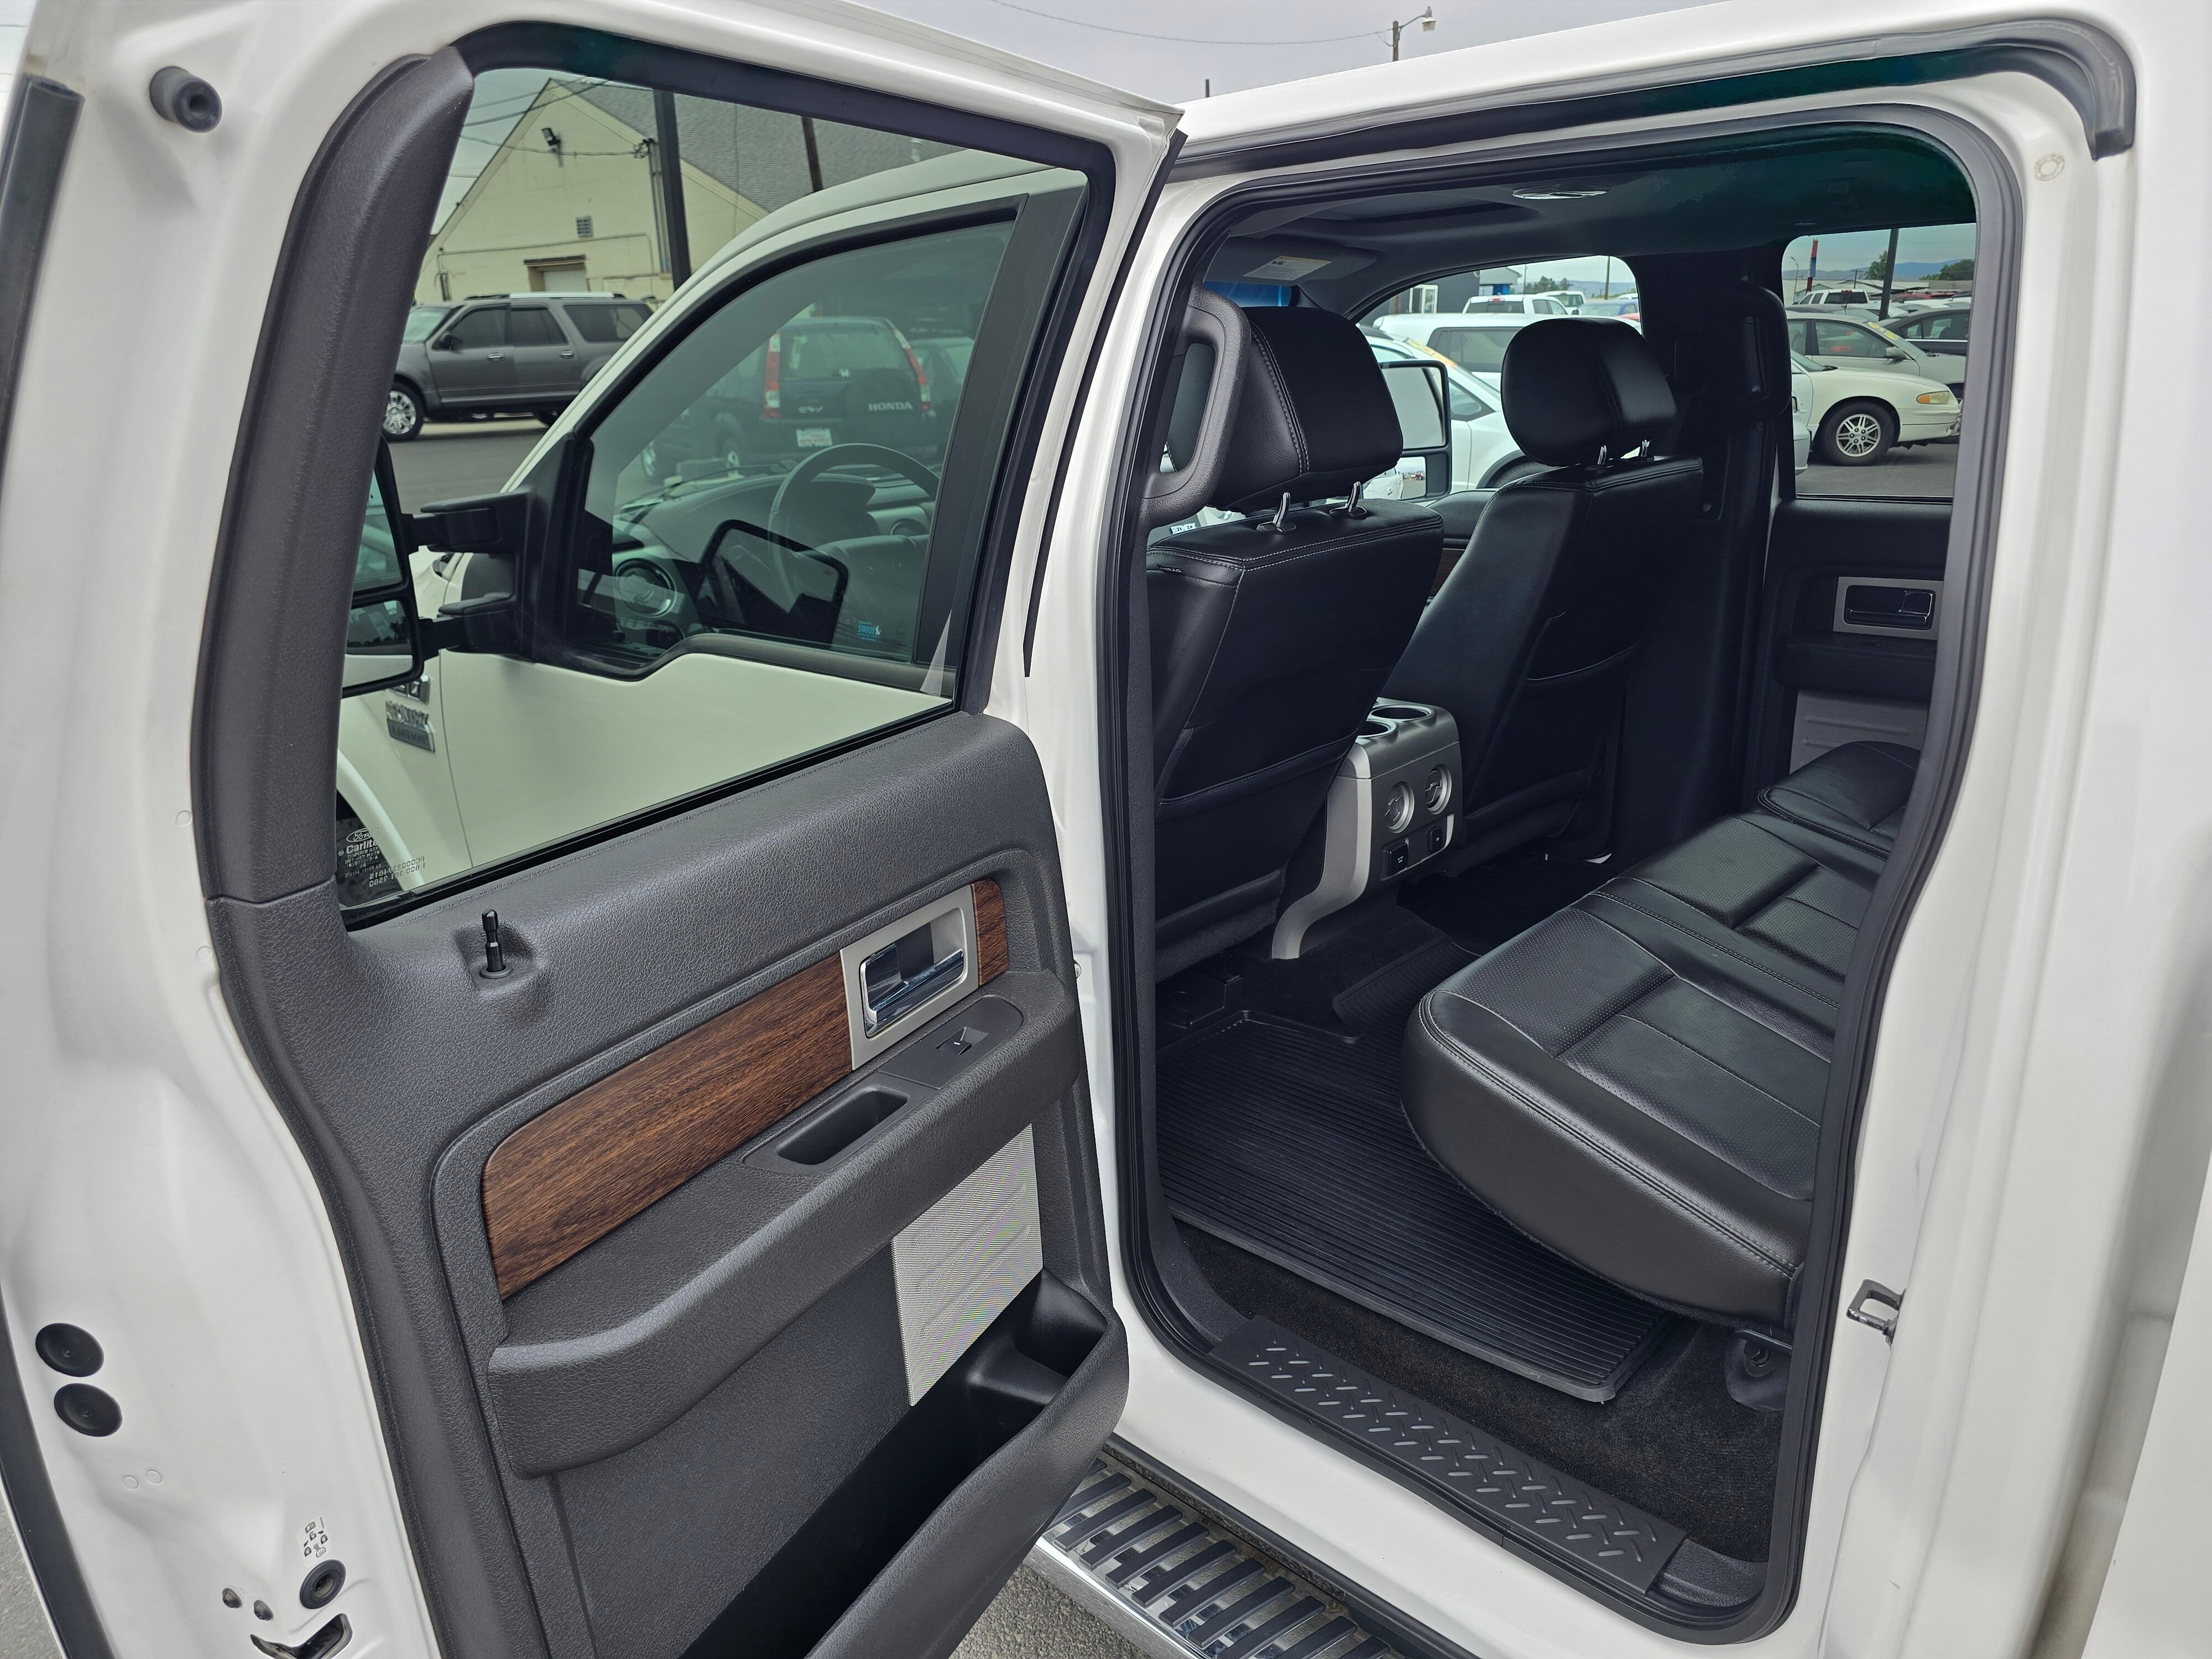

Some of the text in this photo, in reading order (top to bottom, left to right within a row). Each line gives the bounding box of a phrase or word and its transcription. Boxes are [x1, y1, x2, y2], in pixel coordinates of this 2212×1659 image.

[868, 401, 913, 411] HONDA
[858, 624, 875, 634] SIRIUS
[346, 839, 379, 854] Carlite
